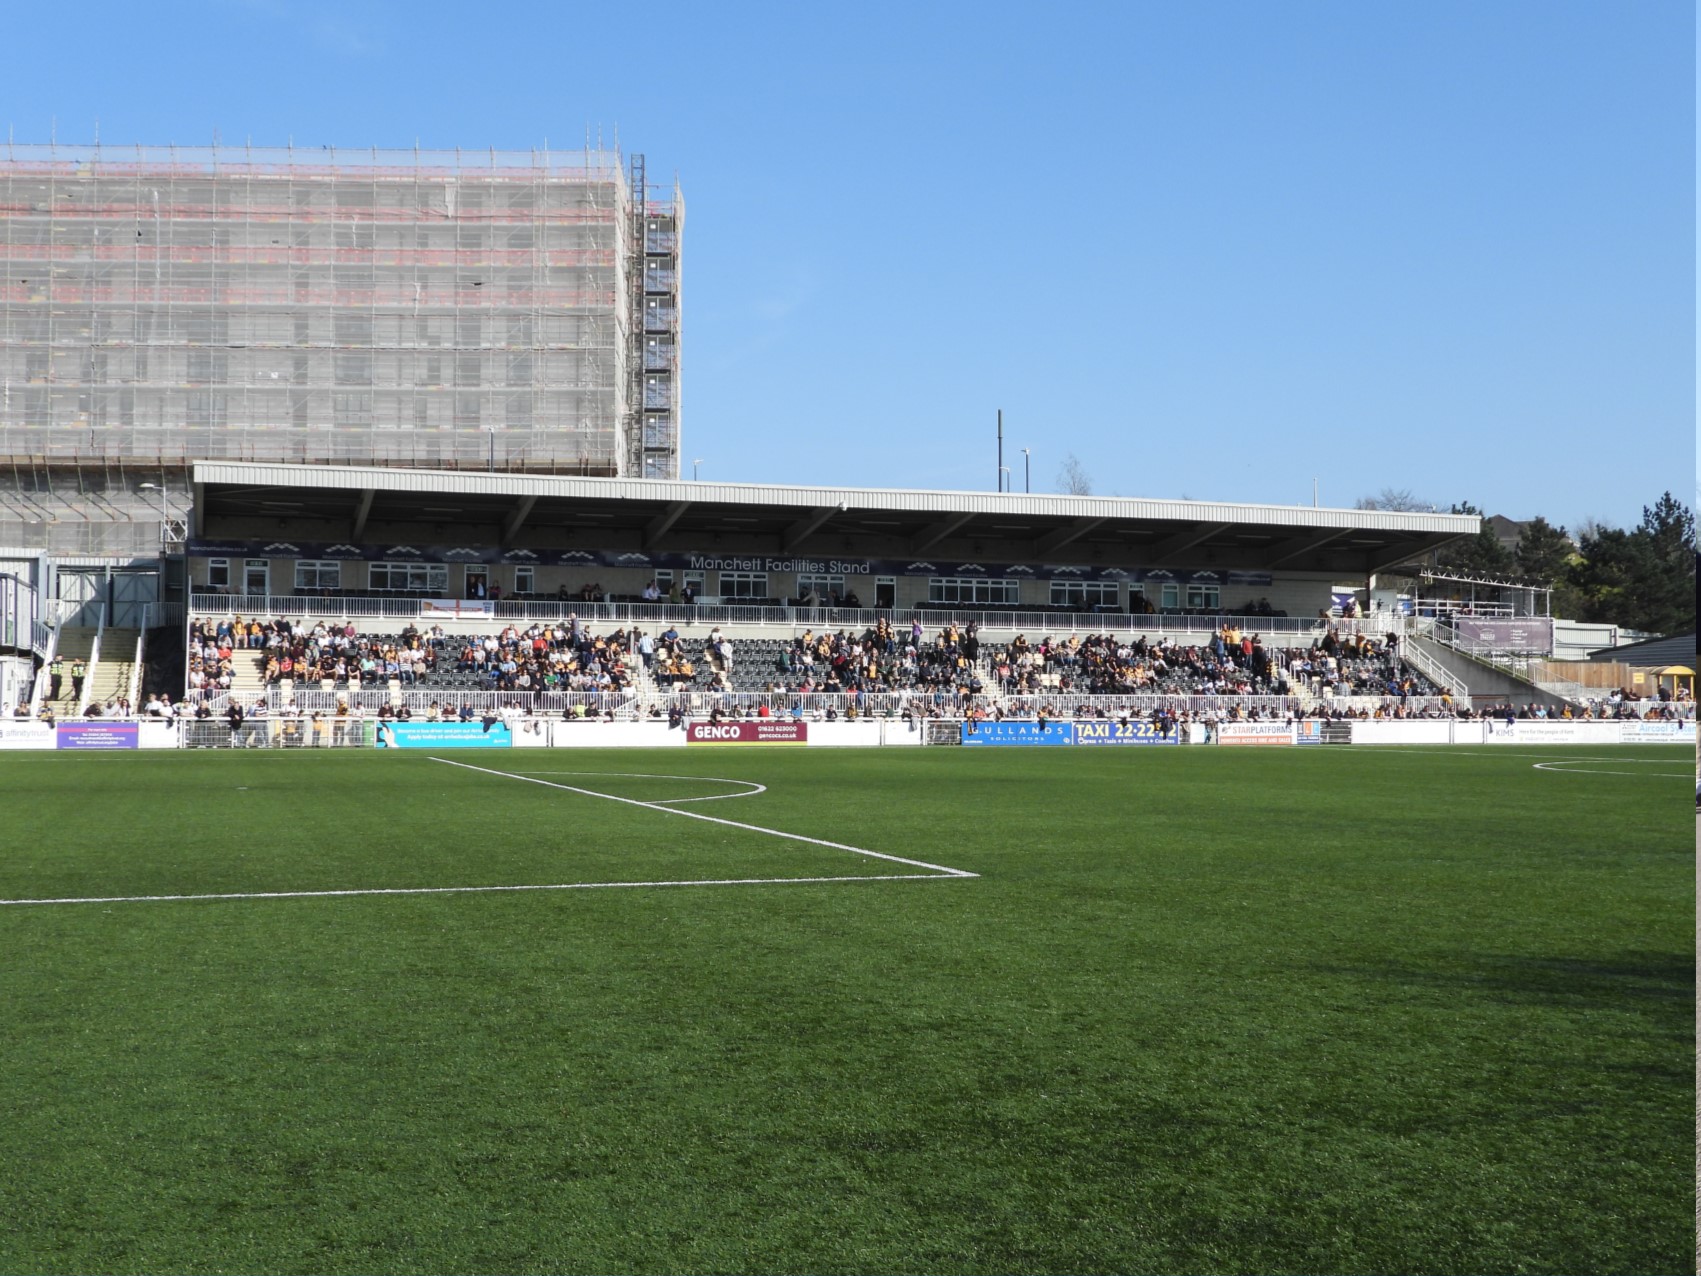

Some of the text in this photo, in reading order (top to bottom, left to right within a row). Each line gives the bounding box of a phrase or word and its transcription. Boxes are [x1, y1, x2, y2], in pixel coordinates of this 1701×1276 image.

[691, 556, 870, 574] Manchett Facilities Stand
[694, 725, 740, 738] GENCO
[1076, 724, 1110, 737] TAXI
